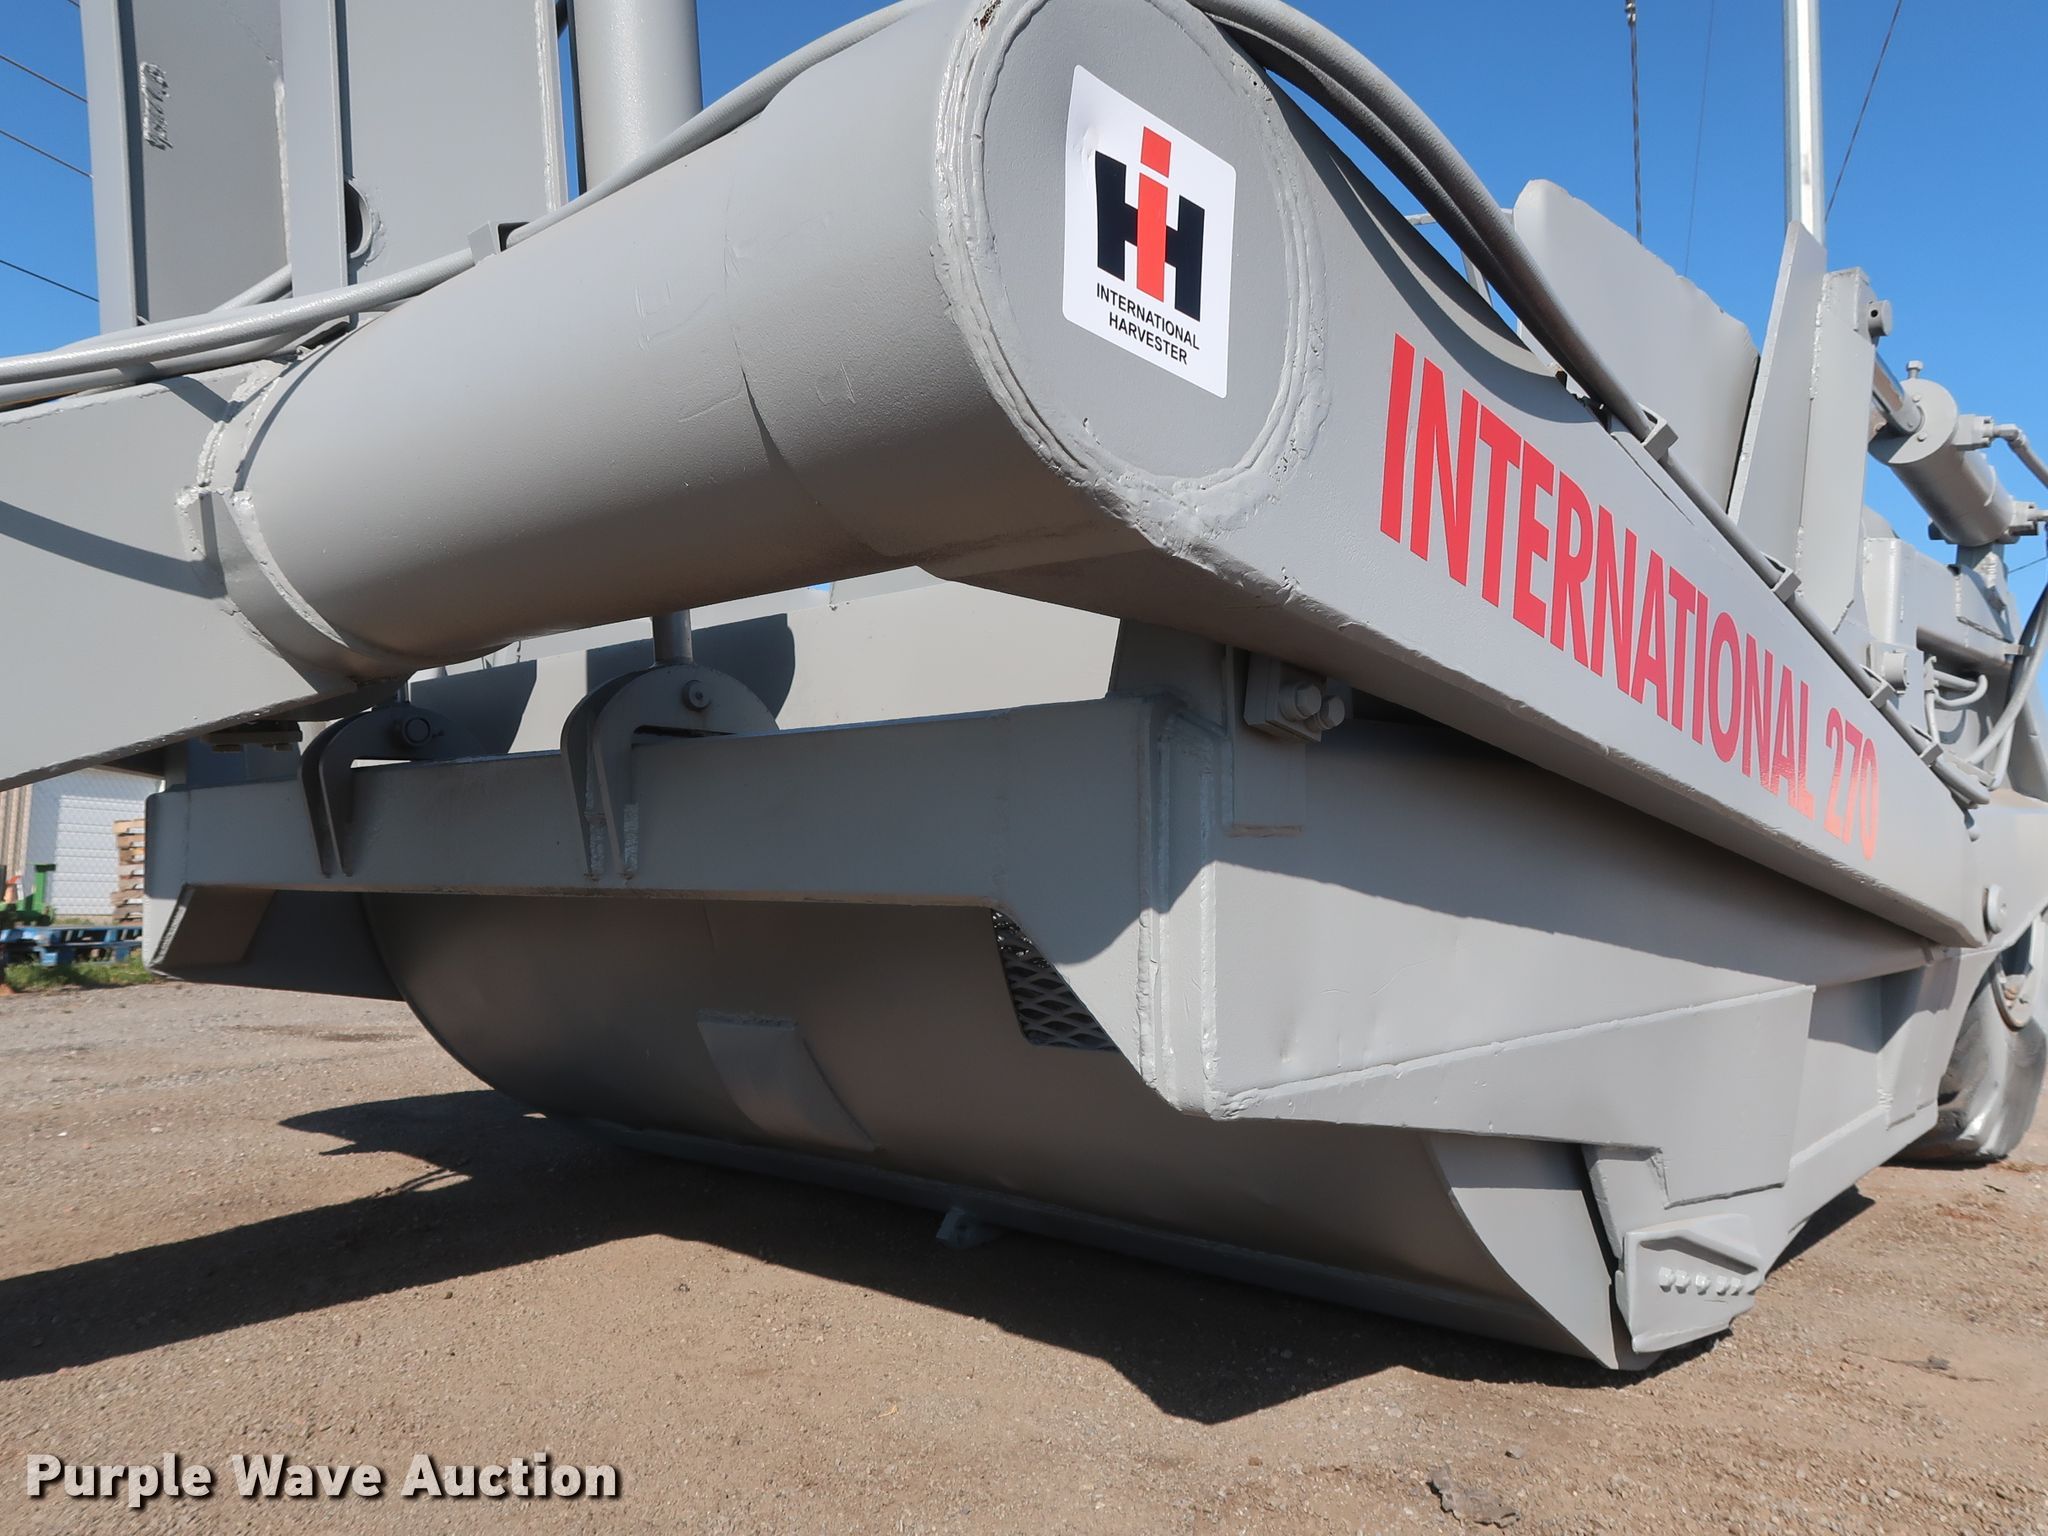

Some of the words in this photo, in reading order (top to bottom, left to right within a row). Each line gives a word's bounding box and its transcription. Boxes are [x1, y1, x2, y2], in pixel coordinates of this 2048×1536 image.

[1096, 283, 1200, 350] INTERNATIONAL
[1108, 311, 1188, 365] HARVESTER
[1380, 333, 1815, 821] INTERNATIONAL
[1823, 707, 1880, 861] 270
